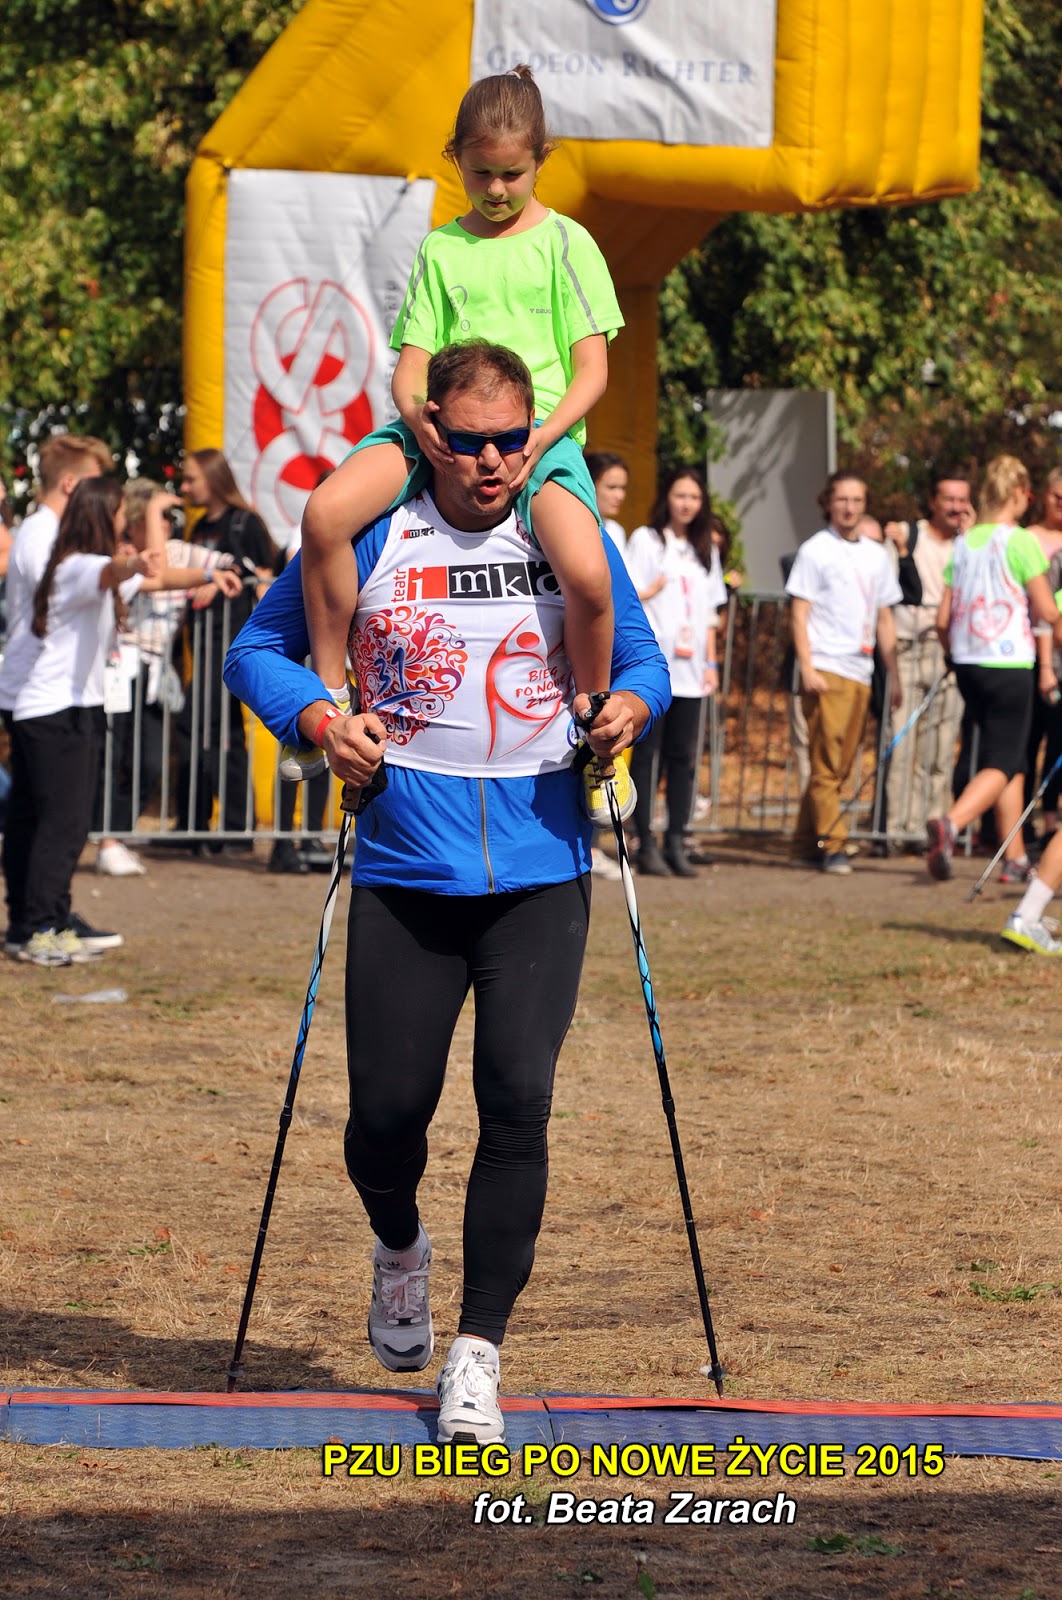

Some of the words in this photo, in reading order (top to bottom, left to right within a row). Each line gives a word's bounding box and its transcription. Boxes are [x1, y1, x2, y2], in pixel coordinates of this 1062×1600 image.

[391, 568, 407, 603] teatr
[528, 666, 558, 682] BIEG
[515, 687, 533, 698] PO
